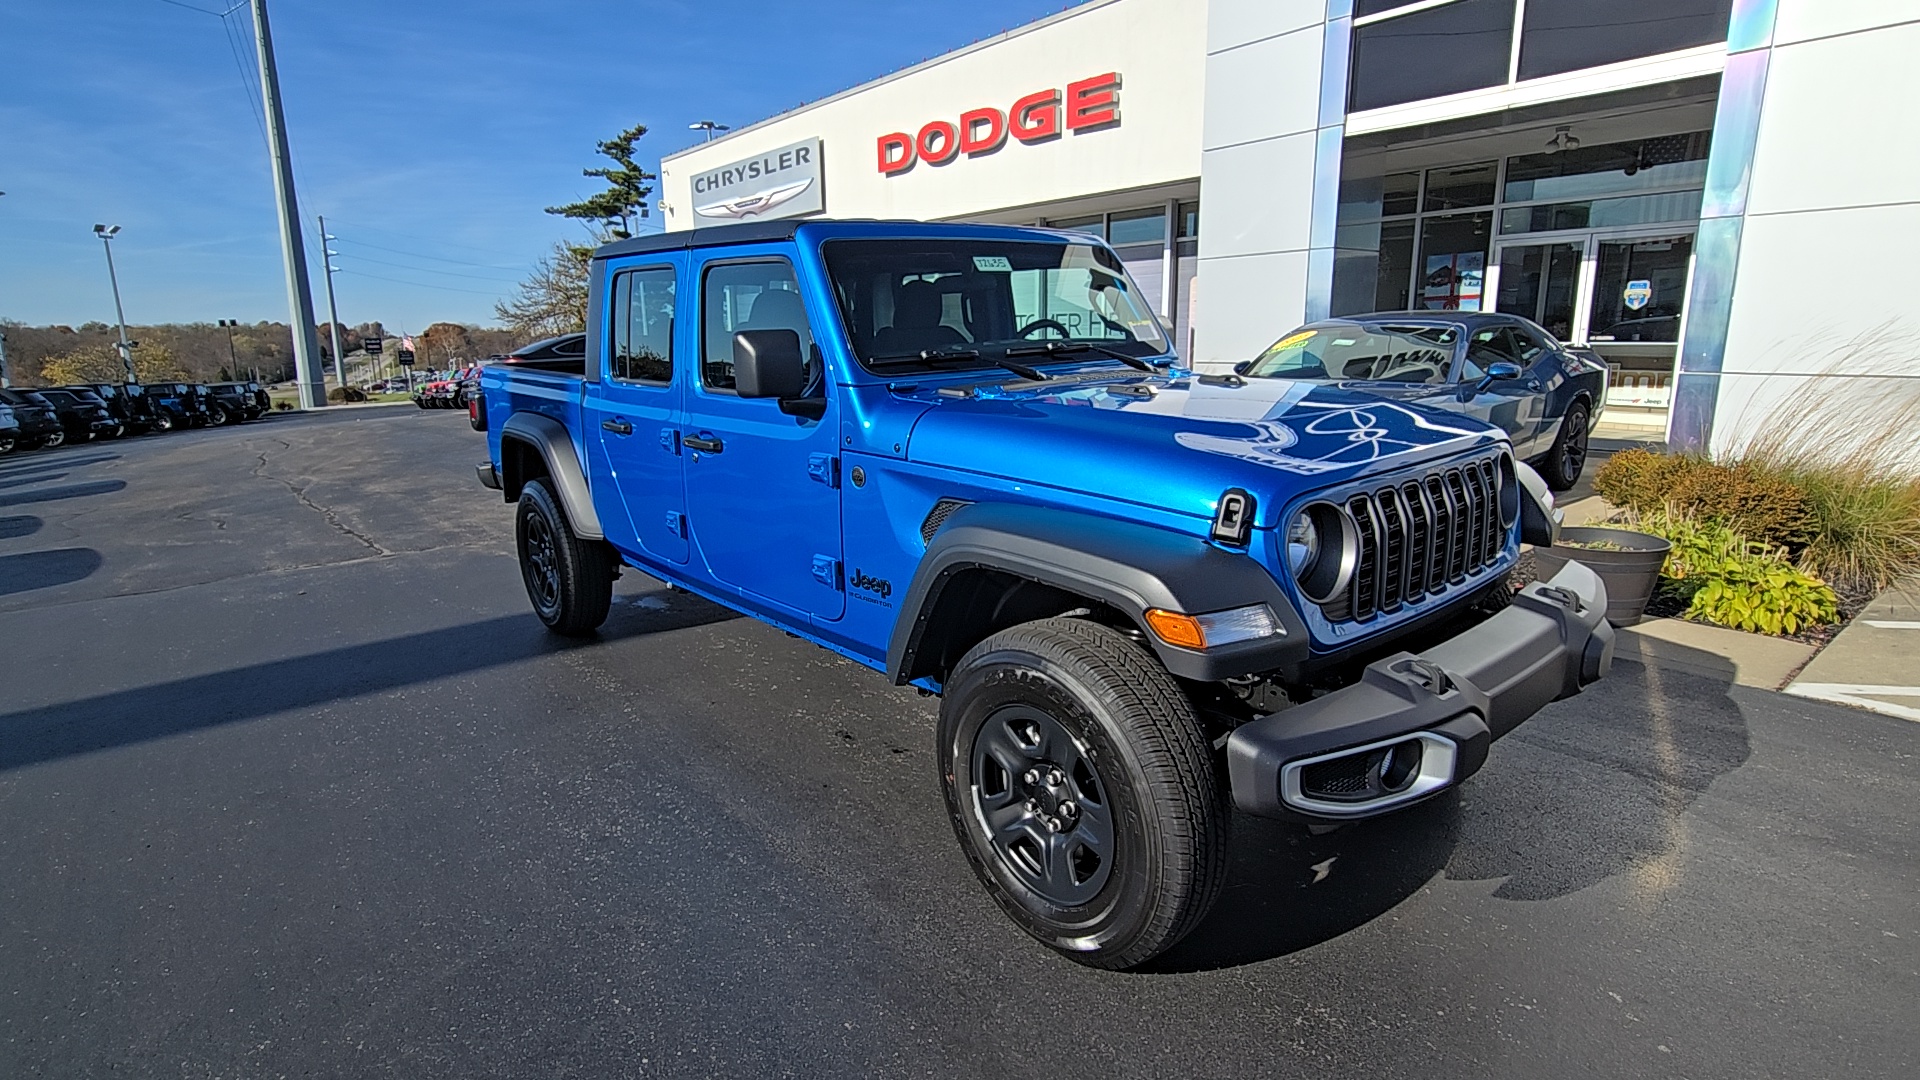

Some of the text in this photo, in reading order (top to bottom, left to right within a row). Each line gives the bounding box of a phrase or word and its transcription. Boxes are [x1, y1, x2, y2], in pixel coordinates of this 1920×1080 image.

[877, 72, 1119, 174] DODGE
[694, 146, 811, 194] CHRYSLER
[849, 567, 892, 599] Jeep
[854, 593, 893, 609] GLADIATOR
